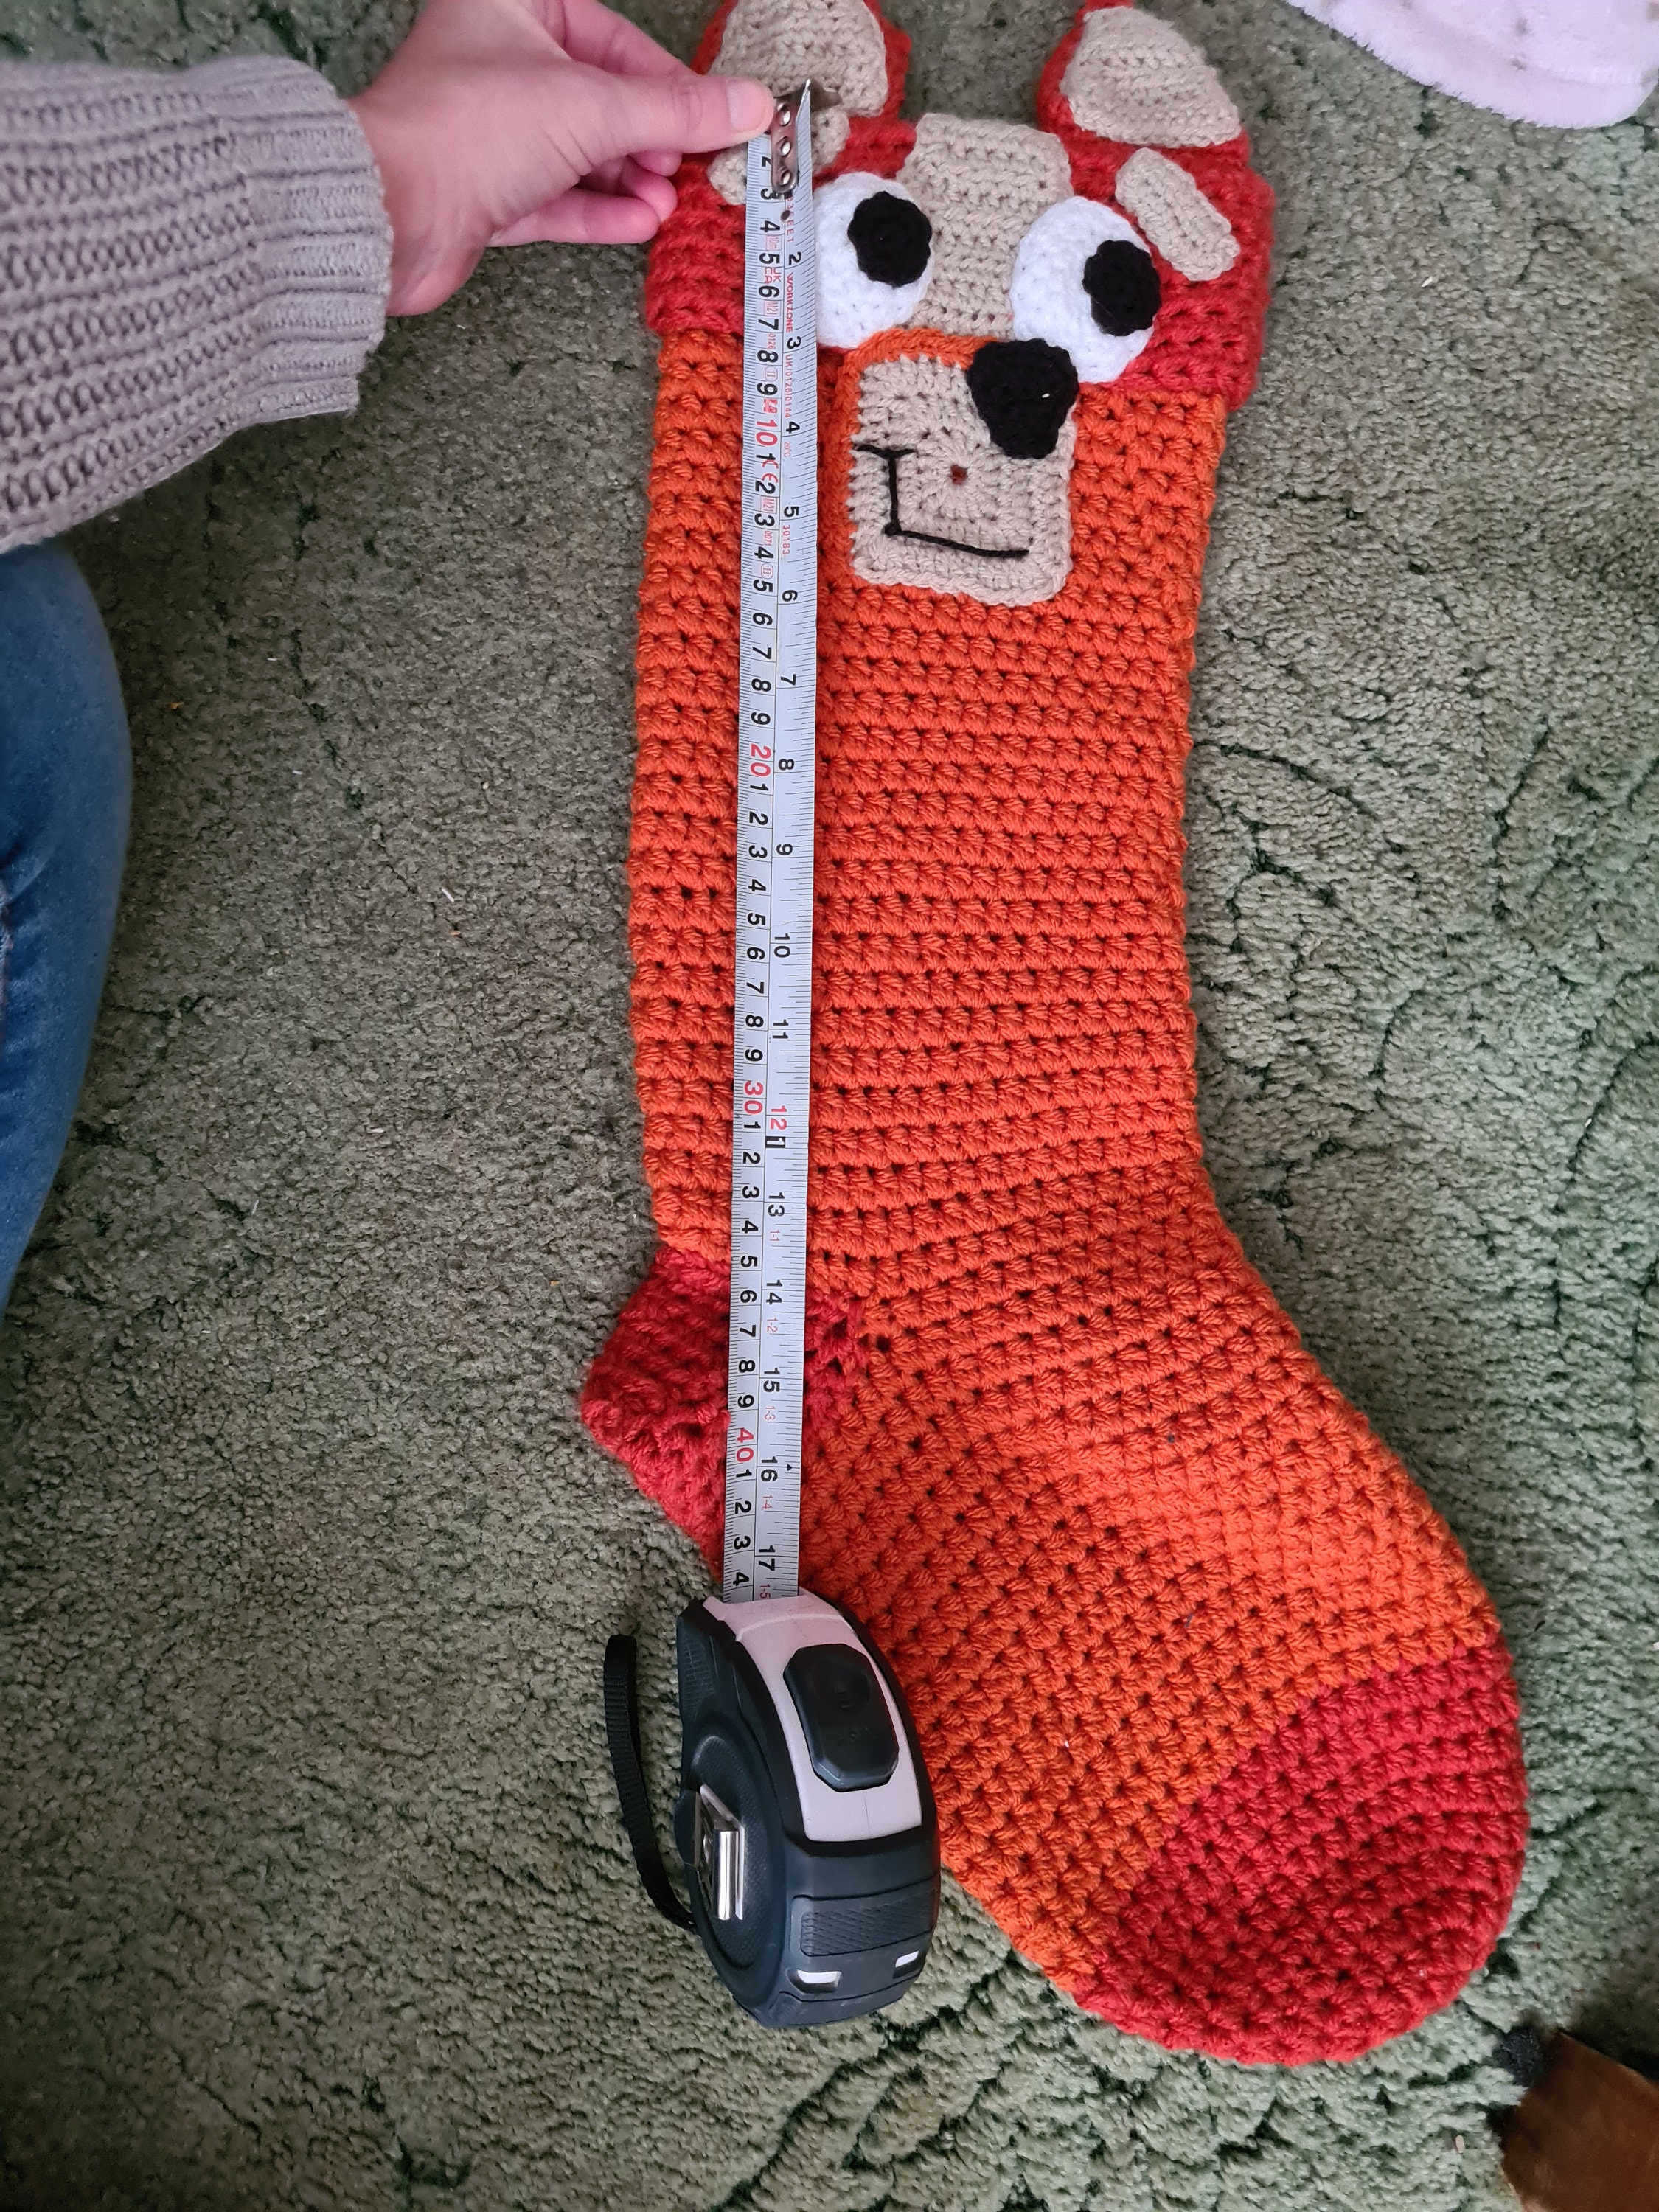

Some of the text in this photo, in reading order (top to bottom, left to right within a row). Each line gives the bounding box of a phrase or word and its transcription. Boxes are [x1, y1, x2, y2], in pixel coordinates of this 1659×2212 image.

[760, 220, 780, 232] 4
[759, 253, 780, 264] 5
[788, 251, 801, 265] 2
[773, 267, 782, 283] UK
[759, 285, 779, 297] 6
[758, 319, 779, 330] 7
[768, 333, 776, 349] 0126
[787, 336, 801, 349] 3
[757, 349, 779, 363] 8
[757, 383, 778, 395] 9
[756, 419, 778, 447] 10
[785, 421, 800, 434] 4
[755, 480, 775, 494] 2
[784, 506, 799, 518] 5
[754, 513, 774, 526] 3
[754, 546, 773, 559] 4
[753, 580, 773, 592] 5
[782, 590, 798, 602] 6
[752, 613, 773, 626] 6
[752, 646, 771, 660] 7
[751, 678, 771, 692] 8
[780, 674, 796, 686] 7
[751, 712, 771, 725] 9
[750, 743, 771, 777] 20
[778, 759, 794, 771] 8
[749, 811, 768, 825] 2
[748, 845, 768, 858] 3
[776, 844, 793, 856] 9
[748, 879, 766, 892] 4
[747, 913, 765, 925] 5
[774, 933, 790, 958] 10
[746, 947, 765, 960] 6
[746, 981, 764, 994] 7
[745, 1015, 764, 1028] 8
[772, 1019, 789, 1039] 11
[745, 1048, 763, 1062] 9
[743, 1081, 763, 1115] 30
[770, 1105, 787, 1130] 12
[742, 1152, 760, 1164] 2
[742, 1186, 759, 1199] 3
[768, 1192, 785, 1217] 13
[742, 1220, 759, 1234] 4
[740, 1256, 758, 1267] 5
[740, 1290, 757, 1303] 6
[766, 1279, 782, 1305] 14
[740, 1324, 757, 1338] 7
[767, 1318, 778, 1332] 1-2
[738, 1360, 755, 1373] 8
[763, 1368, 780, 1392] 15
[737, 1394, 754, 1408] 9
[765, 1406, 776, 1420] 1-3
[737, 1427, 754, 1463] 40
[736, 1469, 752, 1478] 1
[761, 1456, 778, 1482] 16
[735, 1500, 751, 1514] 2
[734, 1536, 751, 1550] 3
[759, 1545, 775, 1571] 17
[733, 1572, 749, 1586] 4
[760, 1584, 771, 1599] 1-5
